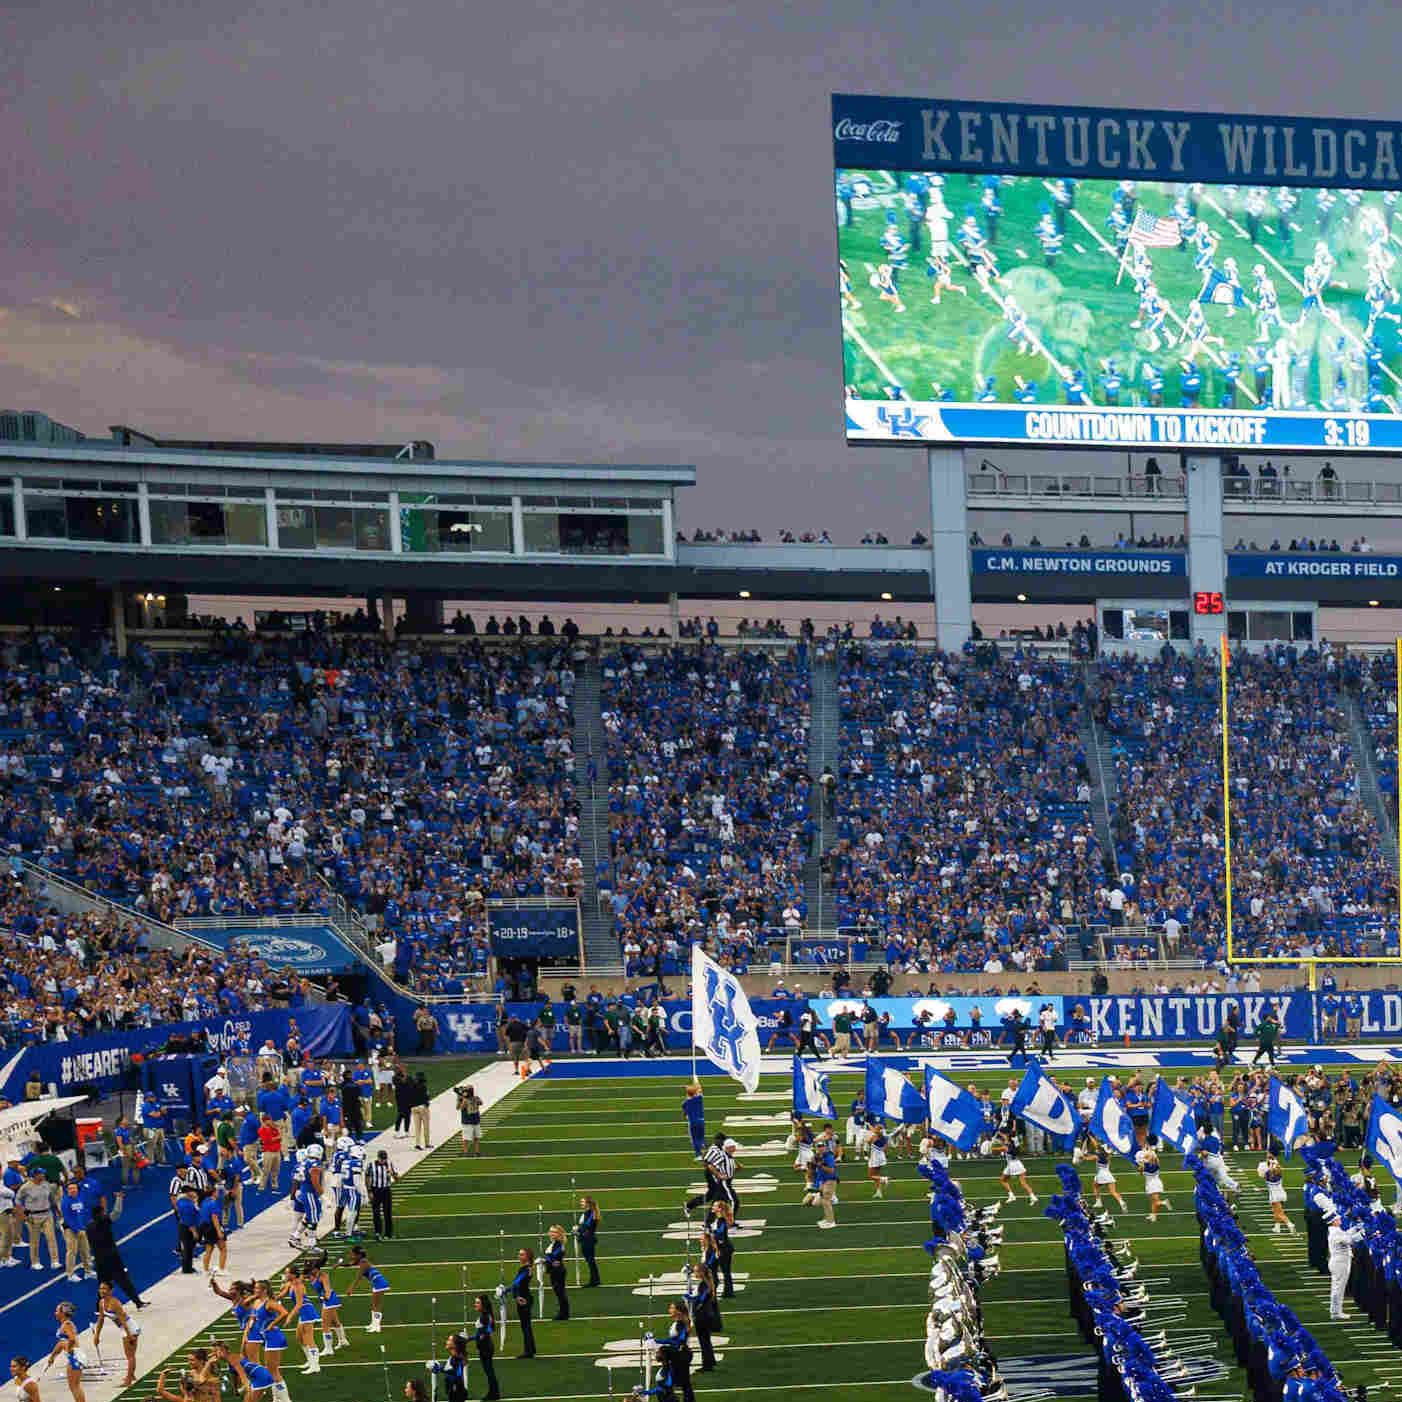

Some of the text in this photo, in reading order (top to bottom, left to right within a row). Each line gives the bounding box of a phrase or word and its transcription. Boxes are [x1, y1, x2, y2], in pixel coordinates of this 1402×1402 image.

[920, 108, 1191, 172] KENTUCKY
[1025, 412, 1267, 444] COUNTDOWN TO KICKOFF
[1324, 419, 1370, 446] 3:19
[987, 557, 1171, 574] C.M. NEWTON GROUNDS
[1264, 562, 1398, 577] AT KROGER FIELD
[1194, 592, 1223, 615] 25
[556, 926, 568, 939] 18
[446, 1013, 483, 1043] UK
